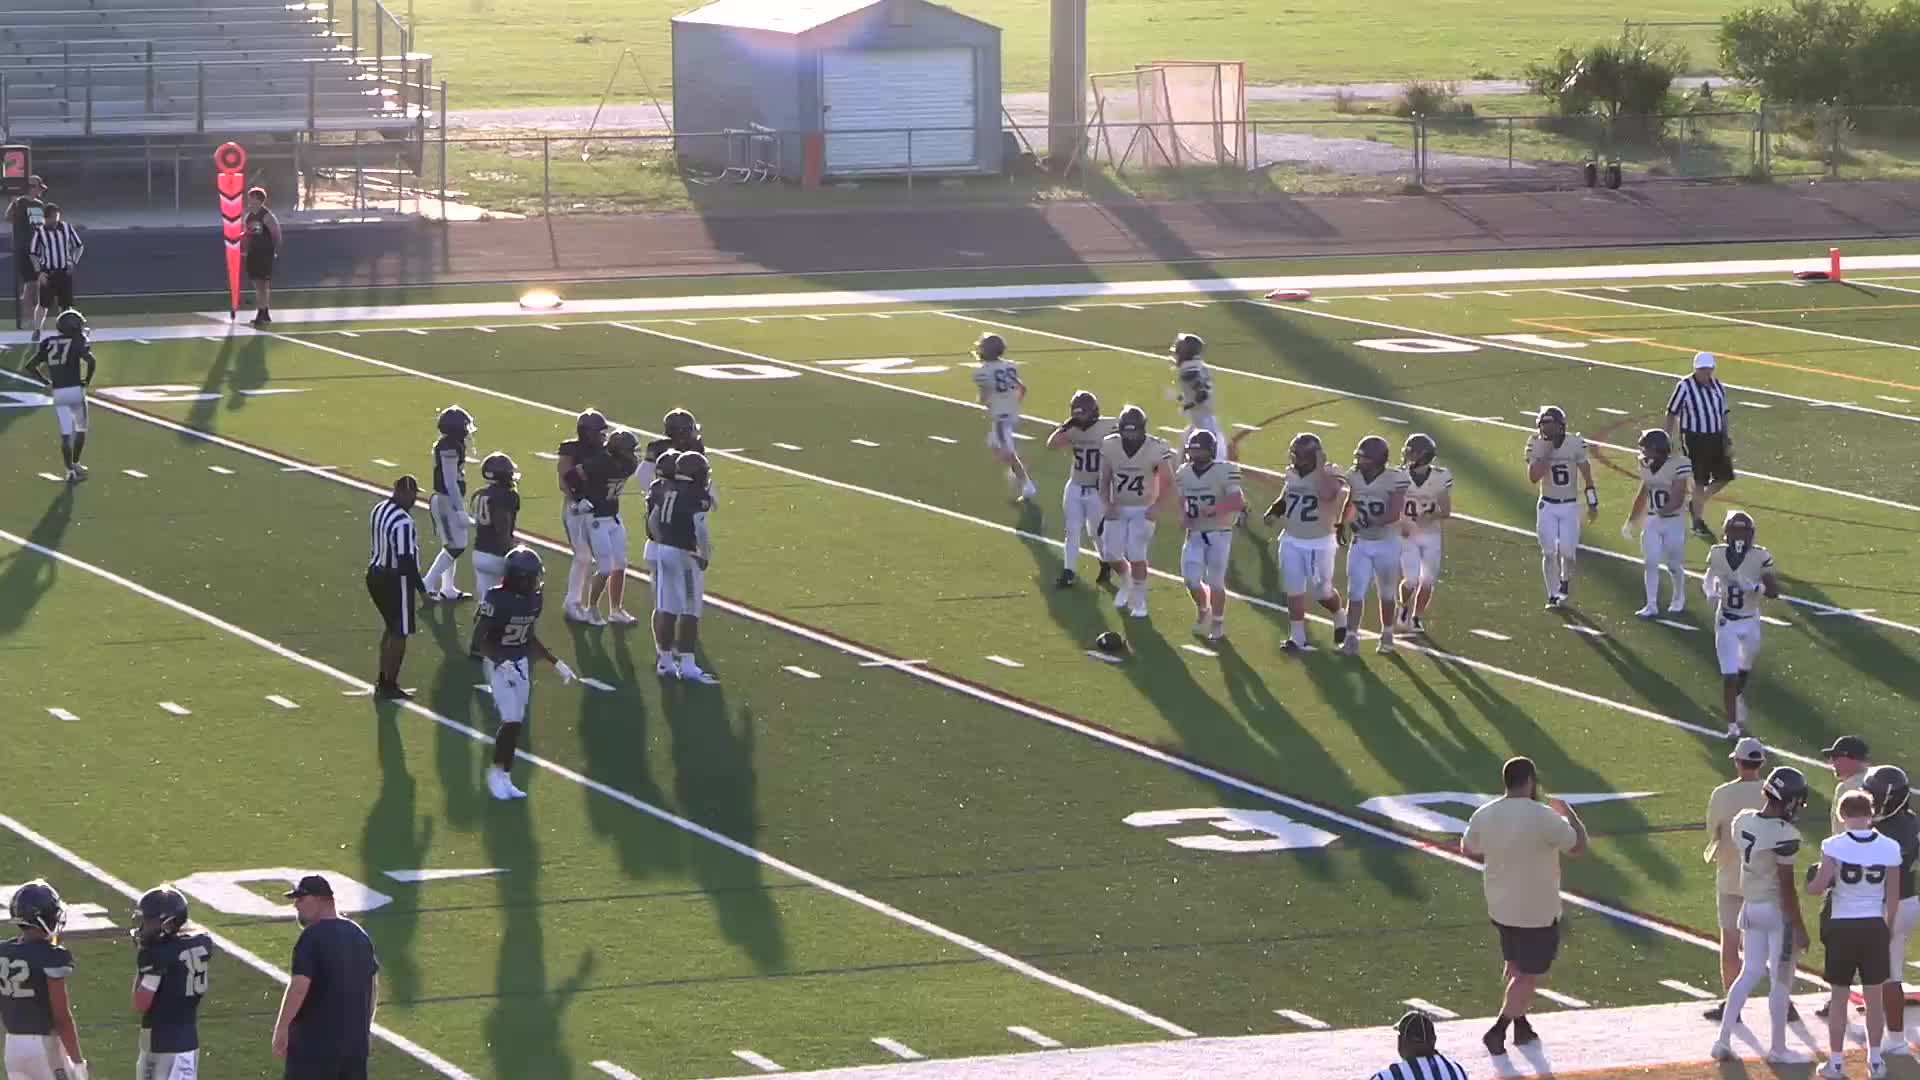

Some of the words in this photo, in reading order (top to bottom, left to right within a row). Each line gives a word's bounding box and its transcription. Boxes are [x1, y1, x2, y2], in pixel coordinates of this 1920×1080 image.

[47, 338, 72, 366] 27
[1073, 448, 1100, 473] 50
[1116, 473, 1145, 496] 74
[1551, 463, 1570, 486] 6
[1287, 493, 1319, 522] 72
[1727, 584, 1745, 609] 8
[1741, 830, 1756, 864] 7
[178, 945, 210, 997] 15
